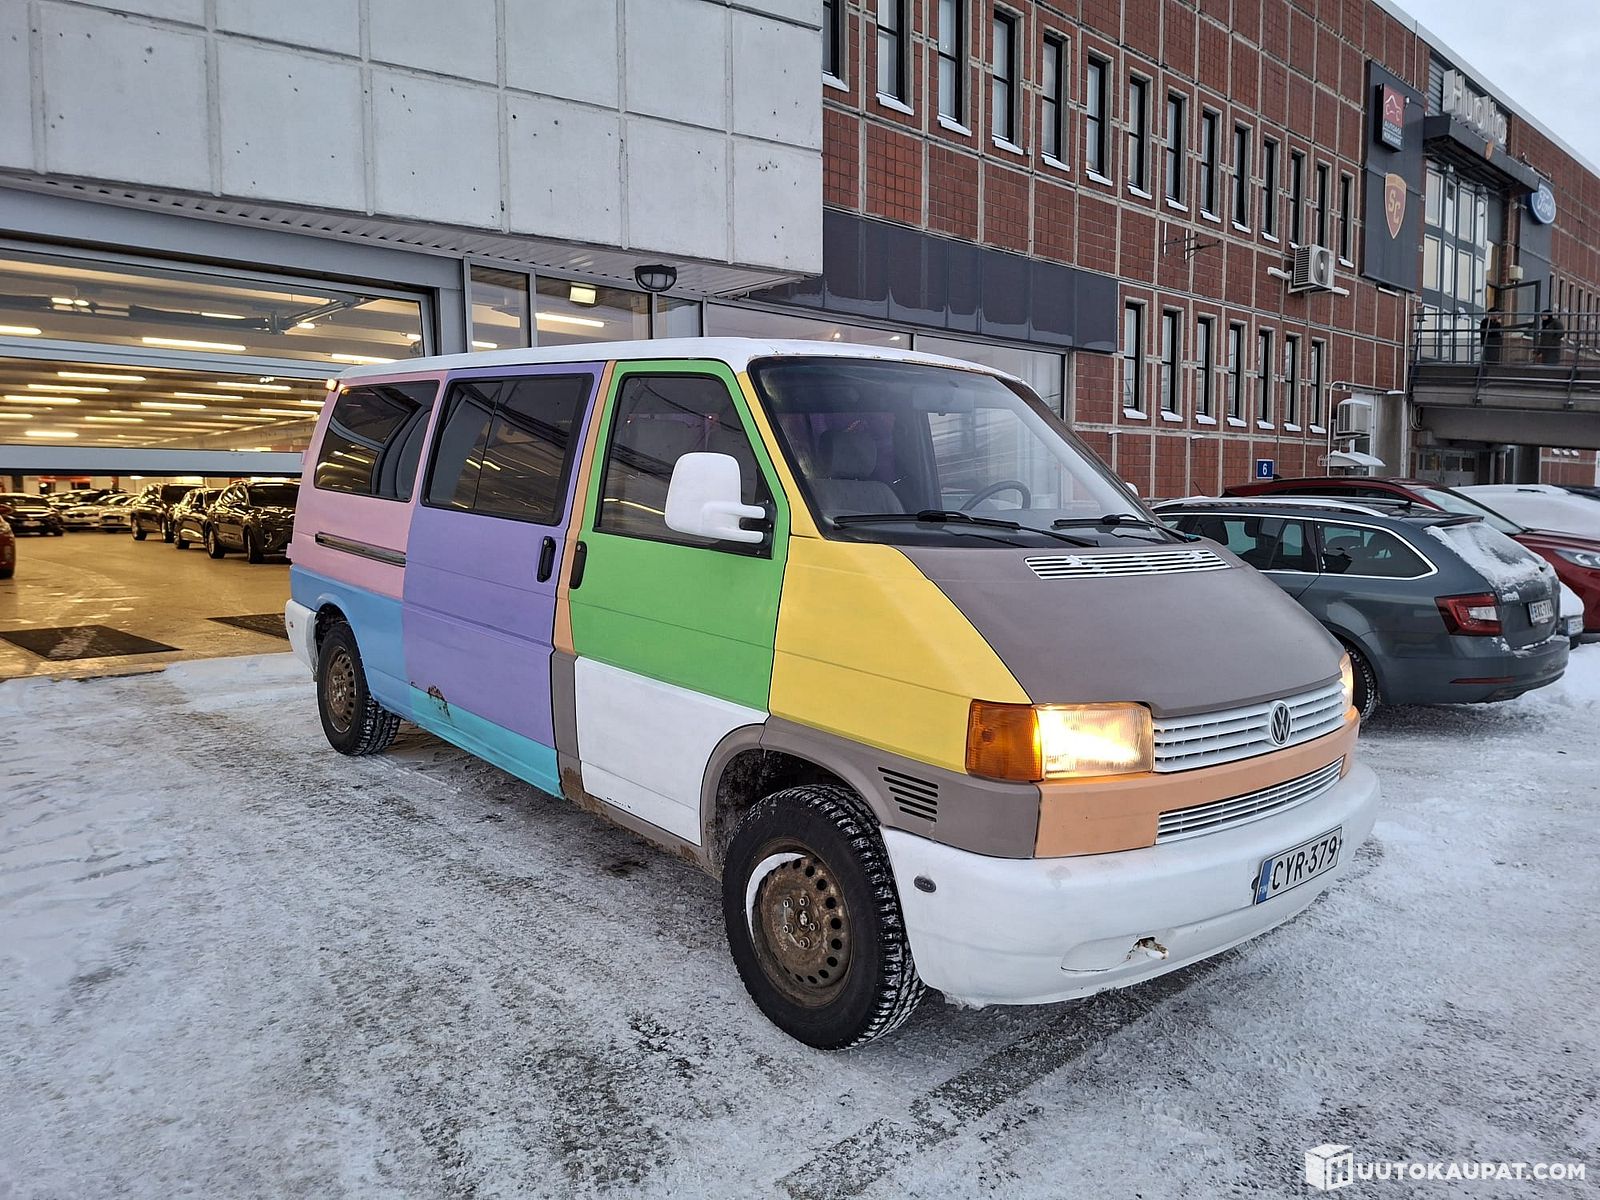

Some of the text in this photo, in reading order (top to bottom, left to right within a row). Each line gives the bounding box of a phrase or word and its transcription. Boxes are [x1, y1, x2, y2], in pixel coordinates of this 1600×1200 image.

[1537, 189, 1552, 217] Ford
[1262, 463, 1268, 476] 6
[1272, 836, 1337, 890] CYR-379
